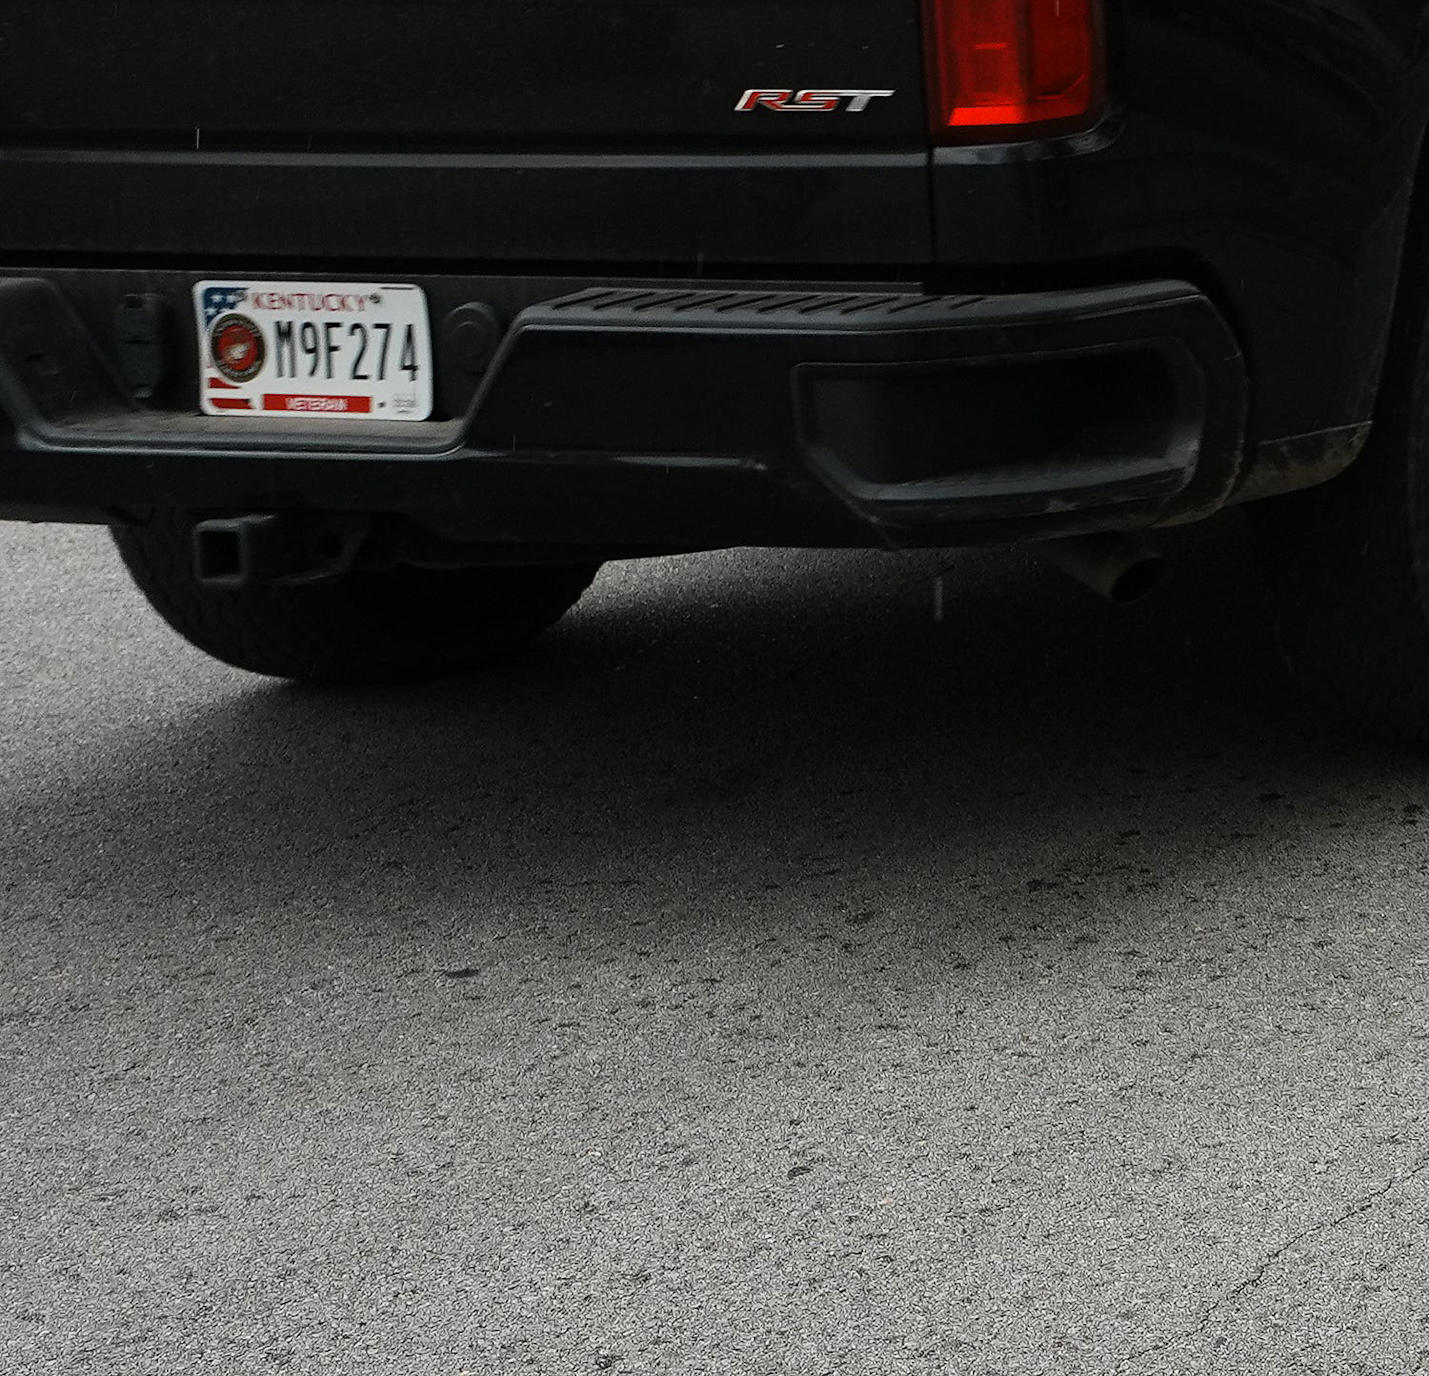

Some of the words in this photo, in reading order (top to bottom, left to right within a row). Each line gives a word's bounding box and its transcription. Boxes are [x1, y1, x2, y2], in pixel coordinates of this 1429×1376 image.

[734, 88, 897, 112] RST
[252, 292, 369, 312] KENTUCKY
[273, 320, 421, 382] M9F274
